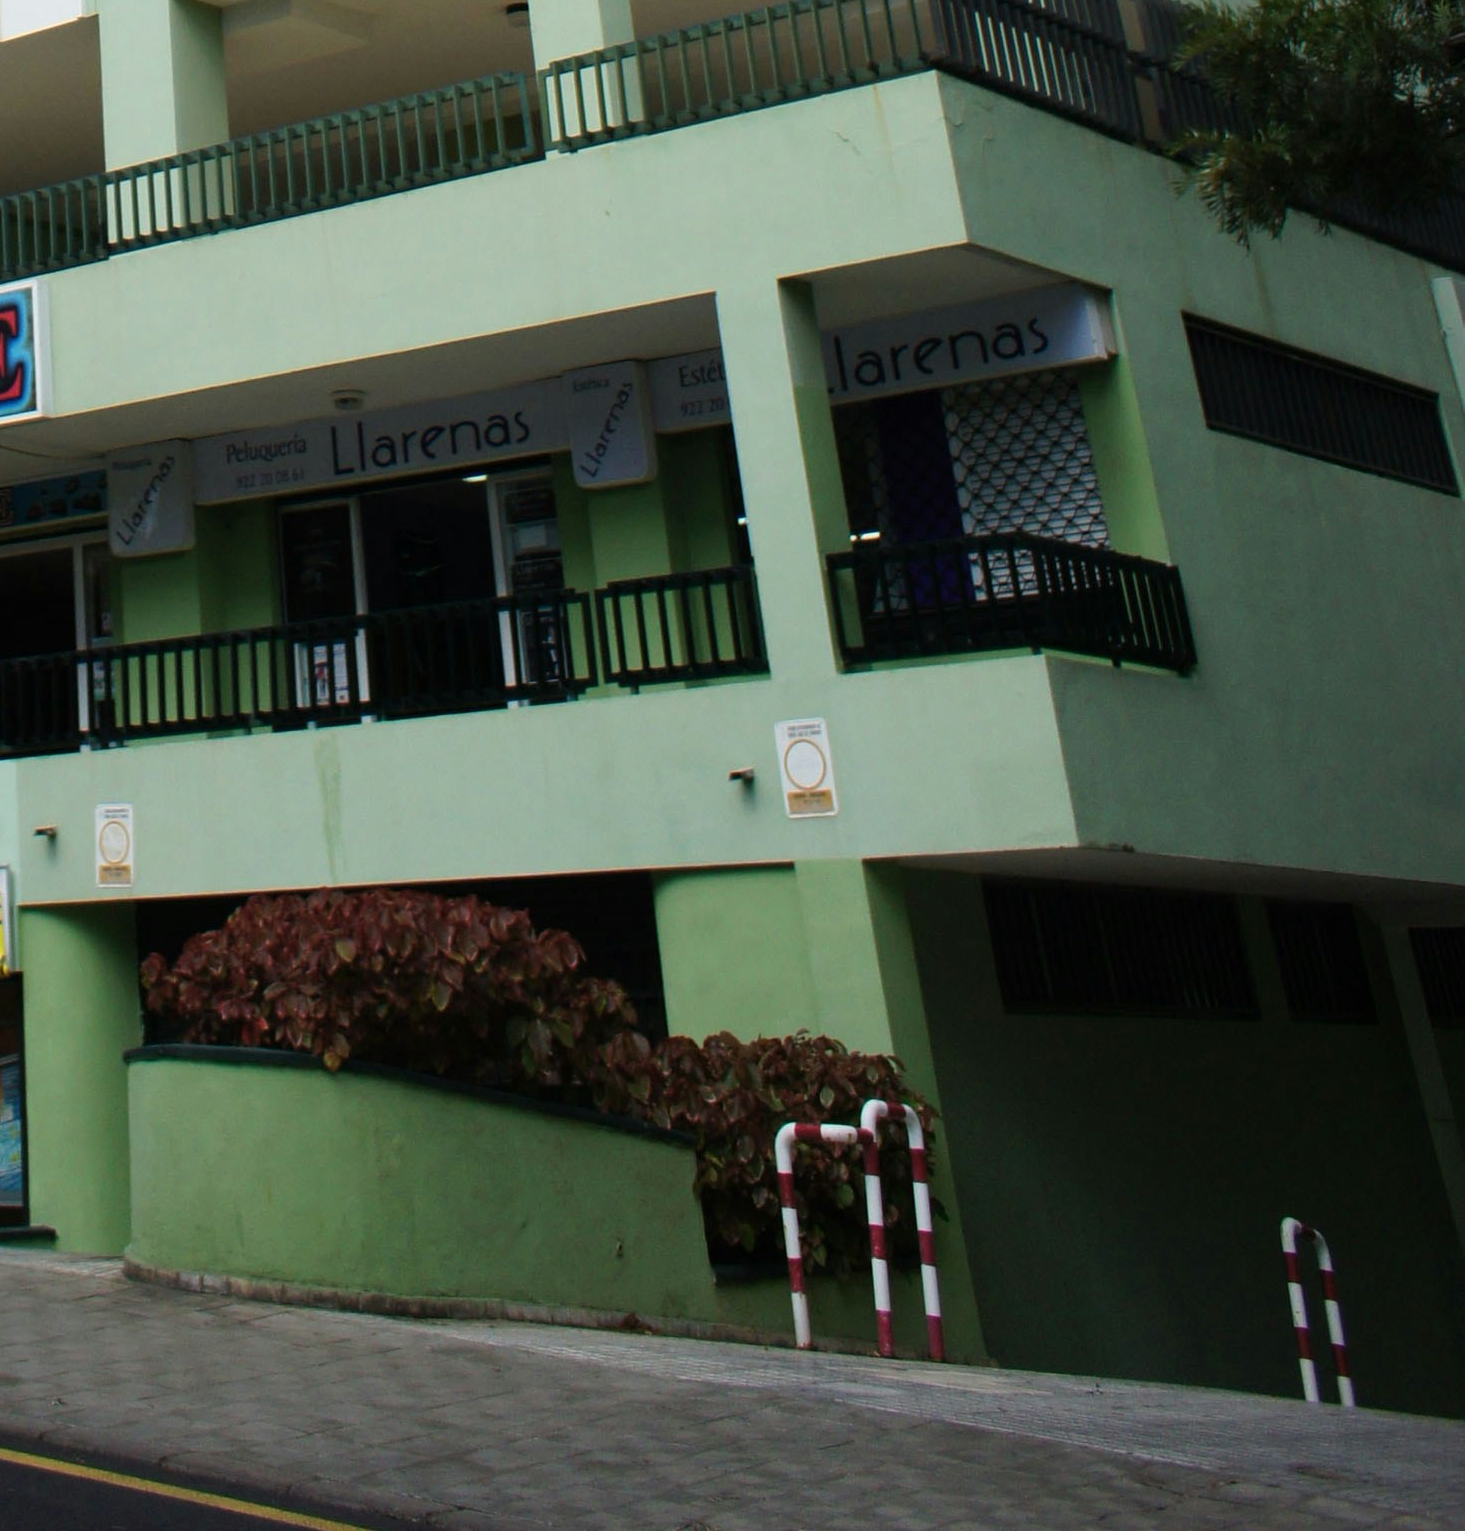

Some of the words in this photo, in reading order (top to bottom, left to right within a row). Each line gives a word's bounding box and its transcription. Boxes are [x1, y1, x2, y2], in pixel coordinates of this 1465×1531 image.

[827, 316, 1049, 393] larenas
[225, 433, 308, 464] Peluquería
[330, 410, 530, 475] Llarenas
[580, 383, 633, 478] Llarenas
[115, 455, 176, 546] Llarenas
